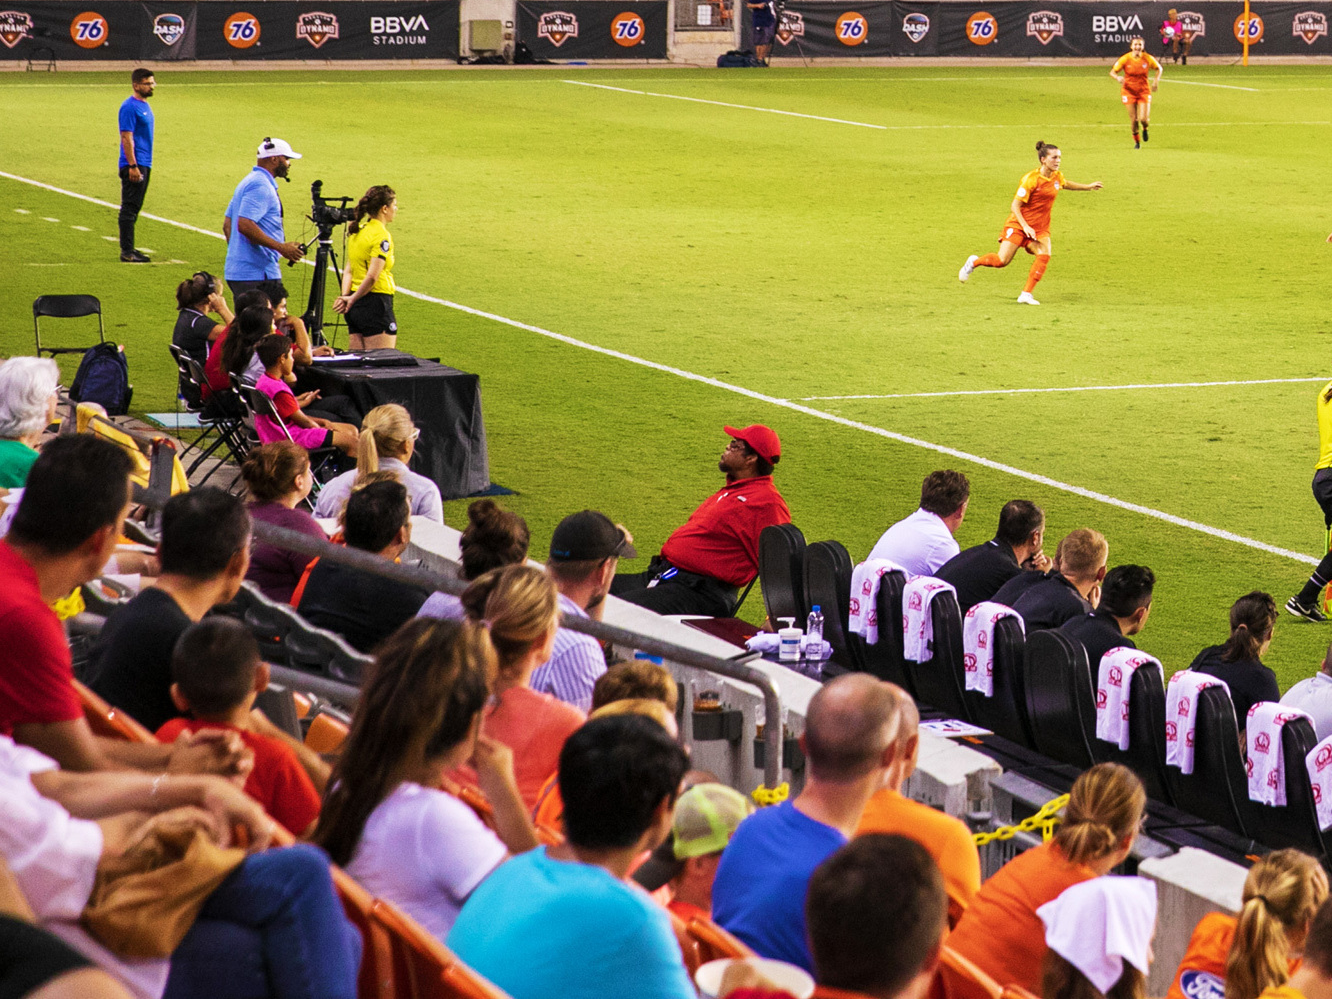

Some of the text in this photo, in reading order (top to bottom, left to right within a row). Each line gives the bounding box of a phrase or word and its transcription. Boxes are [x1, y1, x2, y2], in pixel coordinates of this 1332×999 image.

[76, 18, 104, 41] 76
[153, 25, 185, 35] DASH
[229, 18, 257, 41] 76
[299, 24, 336, 35] DYNAMO
[370, 14, 430, 34] BBVA
[541, 24, 576, 34] DYNAMO
[615, 18, 640, 40] 76
[839, 18, 864, 38] 76
[902, 23, 929, 32] DASH
[970, 17, 994, 38] 76
[1029, 22, 1061, 32] DYNAMO
[1092, 14, 1143, 33] BBVA
[1237, 18, 1259, 38] 76
[1295, 23, 1325, 32] DYNAMO
[373, 35, 427, 45] STADIUM
[1005, 227, 1013, 239] 9
